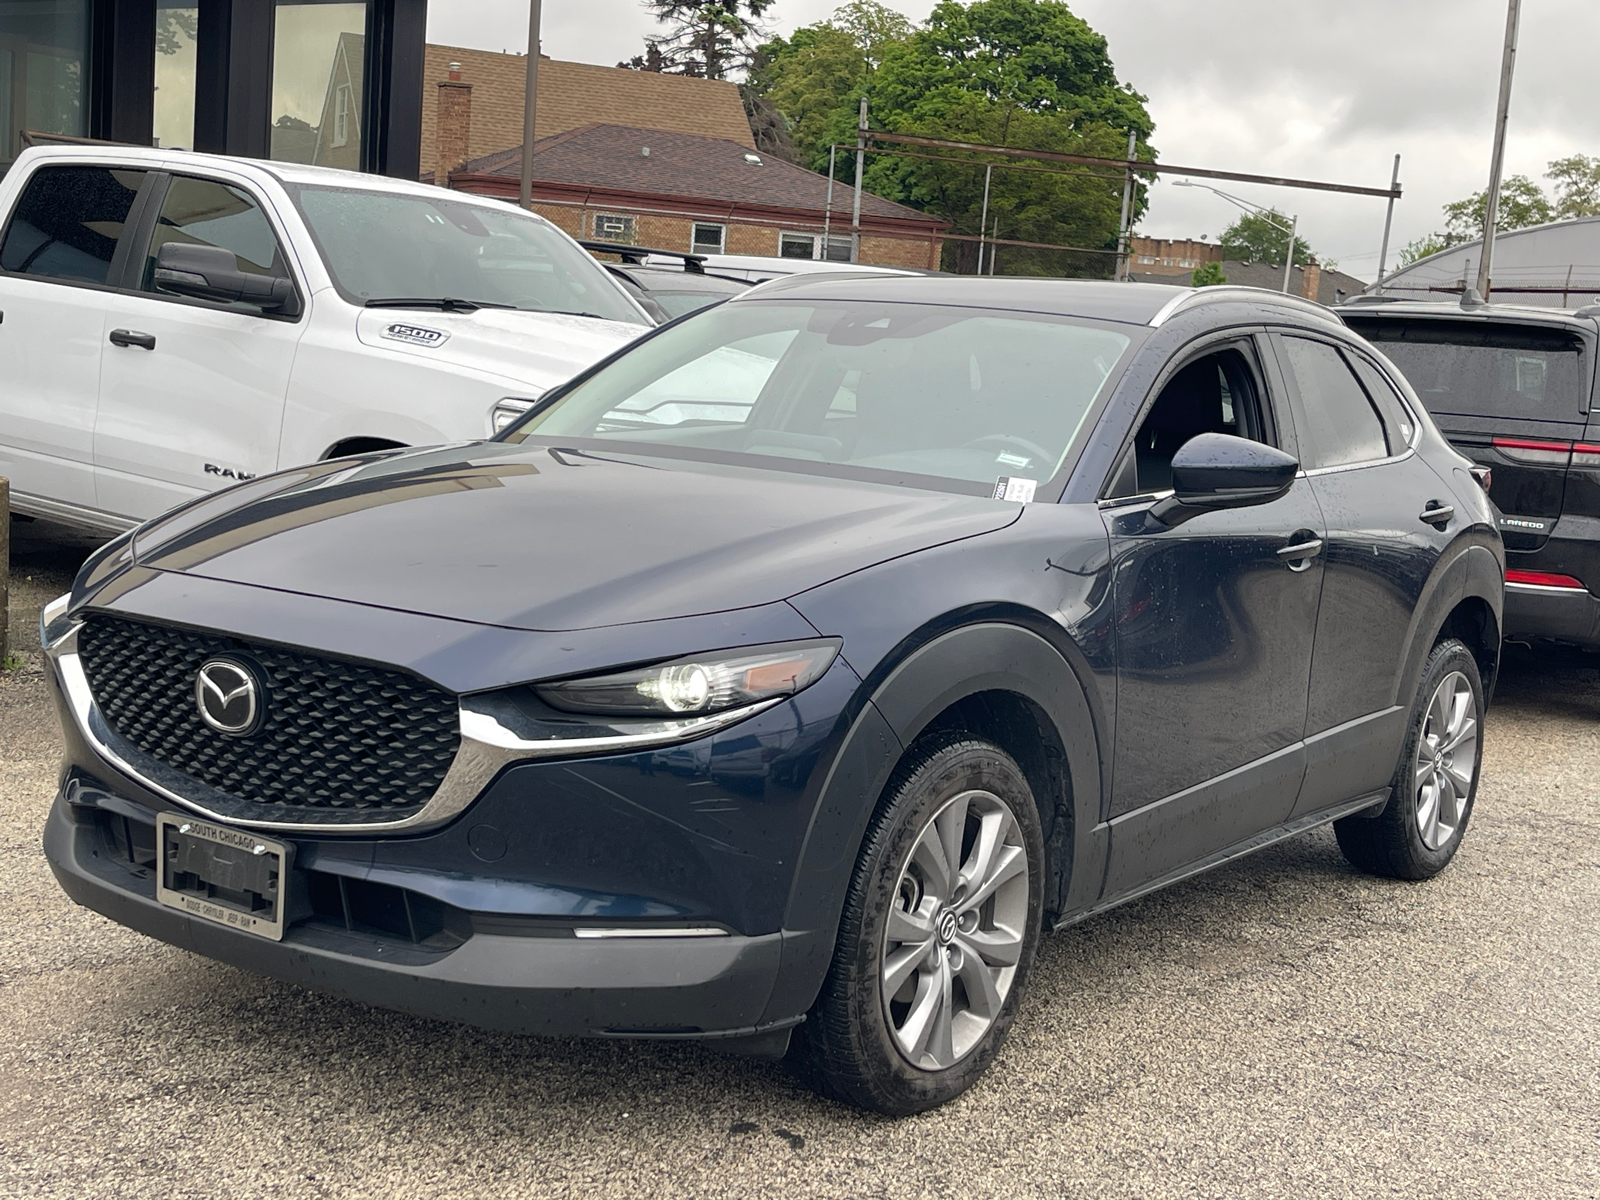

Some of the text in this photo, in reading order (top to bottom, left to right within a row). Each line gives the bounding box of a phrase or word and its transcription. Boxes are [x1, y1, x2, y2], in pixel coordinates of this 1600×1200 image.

[393, 326, 440, 340] 1500
[204, 463, 256, 481] RAM
[1500, 518, 1544, 529] LAREDO
[189, 822, 255, 849] SOUTH CHICAGO
